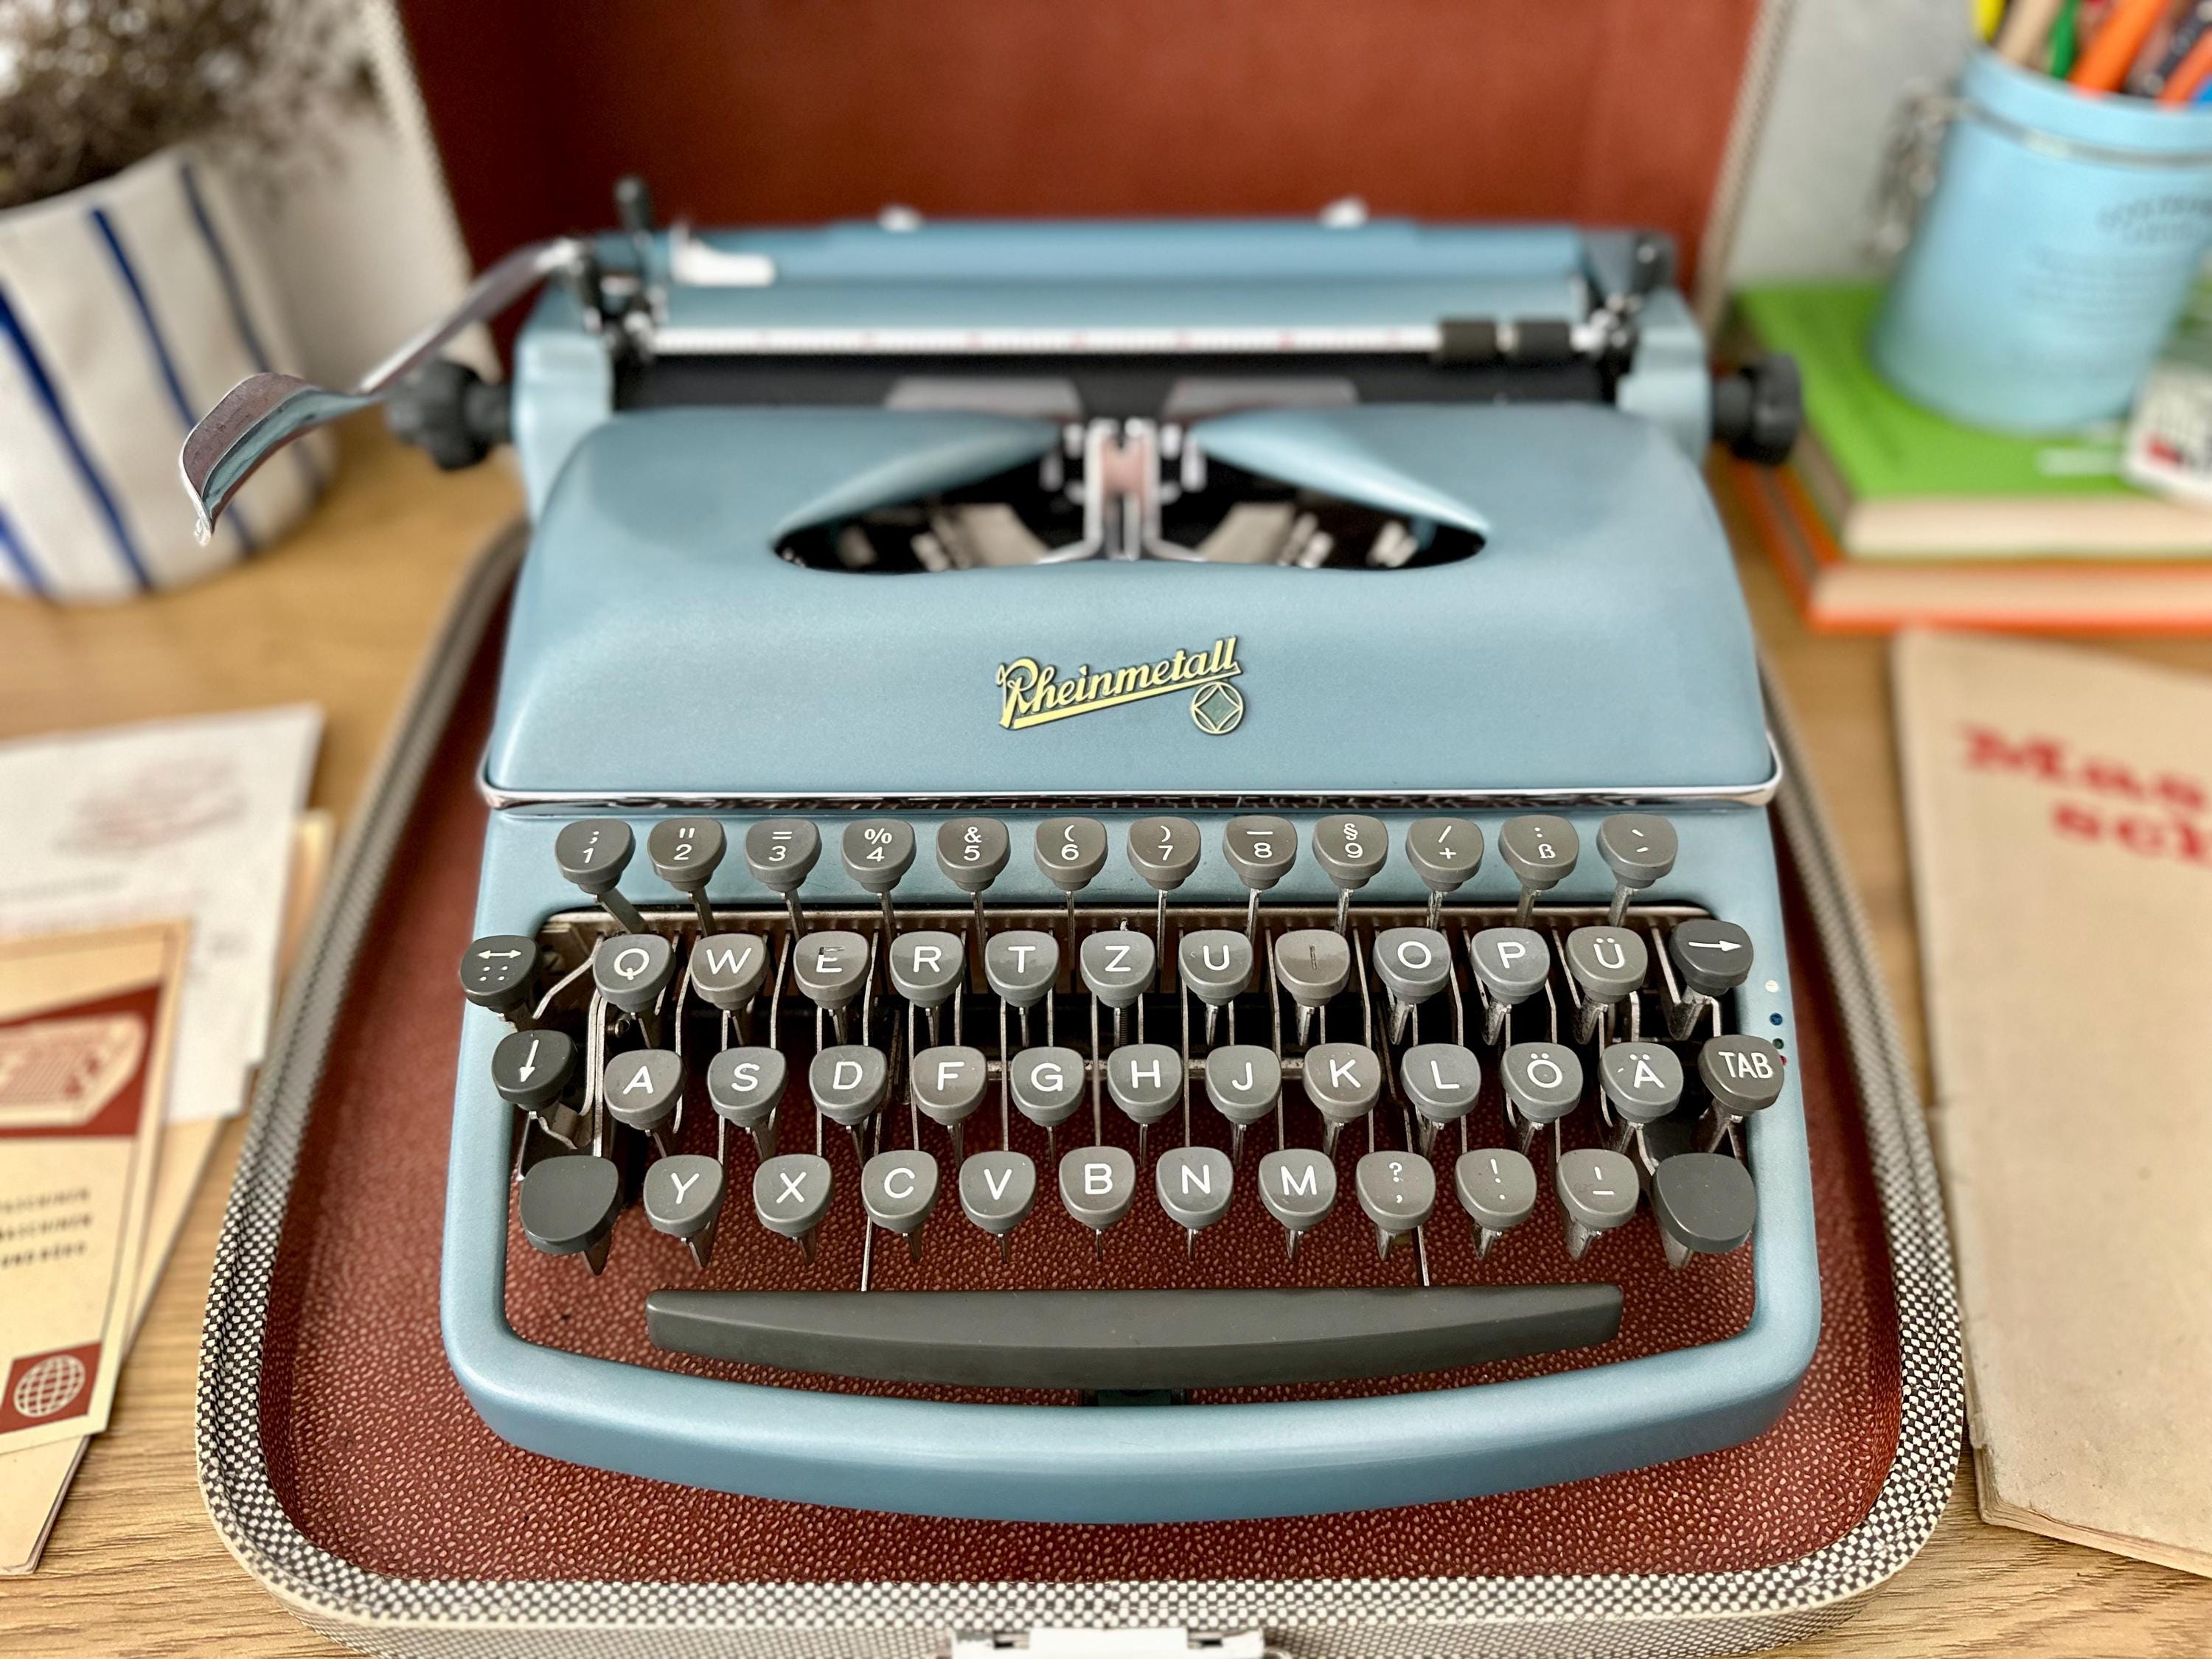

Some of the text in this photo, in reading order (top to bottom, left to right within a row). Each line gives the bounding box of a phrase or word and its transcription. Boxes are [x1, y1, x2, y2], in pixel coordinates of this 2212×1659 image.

[996, 636, 1242, 729] Rheinmetall
[864, 827, 892, 845] %
[964, 826, 982, 844] &
[1064, 824, 1074, 843] (
[1160, 825, 1171, 843] )
[1343, 823, 1358, 841] §
[582, 847, 594, 863] 1
[673, 844, 692, 860] 2
[768, 845, 787, 862] 3
[866, 846, 885, 862] 4
[963, 845, 981, 861] 5
[1061, 844, 1079, 860] 6
[1158, 844, 1174, 861] 7
[1253, 842, 1273, 858] 8
[1344, 842, 1363, 859] 9
[613, 947, 650, 981] Q
[706, 947, 752, 975] W
[815, 946, 846, 973] E
[913, 945, 942, 973] R
[1007, 945, 1037, 973] T
[1105, 945, 1132, 972] Z
[1203, 945, 1230, 971] U
[1397, 941, 1432, 970] O
[1497, 942, 1526, 969] P
[1593, 937, 1626, 969] Ü
[731, 1062, 760, 1092] S
[832, 1061, 863, 1090] D
[938, 1061, 965, 1091] F
[1031, 1062, 1063, 1092] G
[1130, 1059, 1161, 1089] H
[1231, 1062, 1253, 1091] J
[1329, 1059, 1361, 1088] K
[1430, 1060, 1460, 1089] L
[1526, 1053, 1563, 1088] Ö
[1630, 1054, 1666, 1088] Ä
[1718, 1051, 1774, 1079] TAB
[622, 1065, 654, 1095] A
[883, 1167, 916, 1199] C
[984, 1168, 1012, 1200] V
[1084, 1163, 1113, 1194] B
[1181, 1164, 1211, 1194] N
[1280, 1165, 1318, 1196] M
[1388, 1161, 1402, 1183] ?
[1490, 1158, 1501, 1183] !
[670, 1172, 700, 1205] Y
[776, 1171, 807, 1204] X
